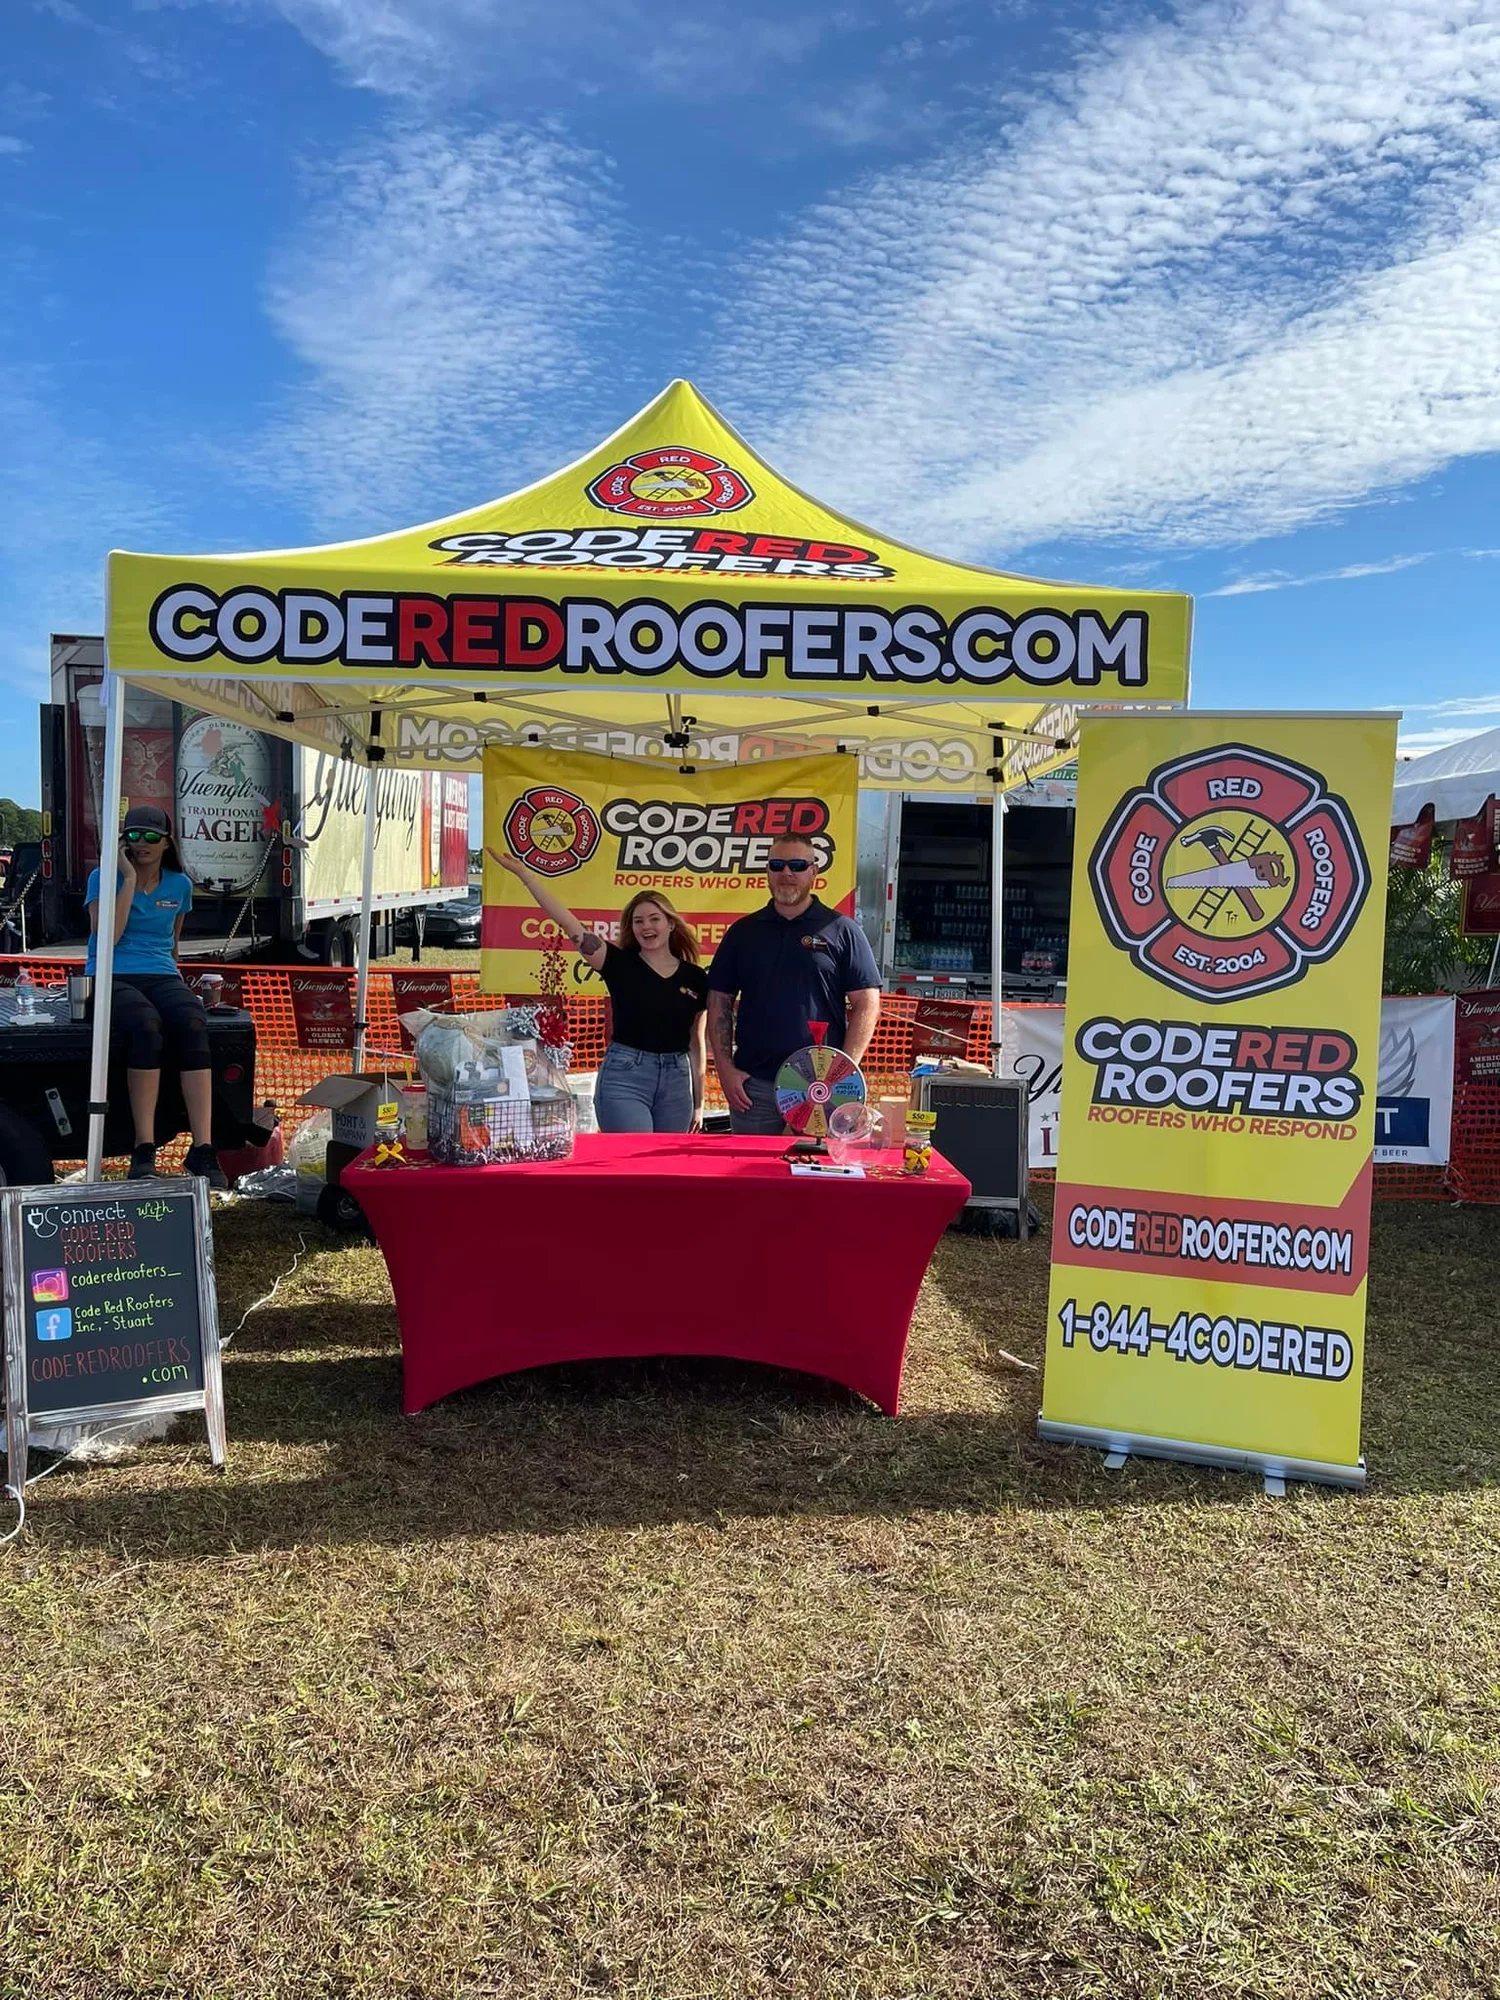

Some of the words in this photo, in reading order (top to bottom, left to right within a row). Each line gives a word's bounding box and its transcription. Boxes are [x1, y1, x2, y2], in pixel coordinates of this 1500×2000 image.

[659, 456, 691, 464] RED
[610, 475, 627, 497] CODE
[716, 474, 735, 504] ROOFERS
[662, 504, 695, 513] 2004
[438, 529, 871, 564] CODERED
[459, 550, 890, 578] ROOFERS
[153, 588, 1144, 683] CODEREDROOFERS.COM
[544, 796, 563, 804] RED
[1207, 777, 1262, 799] RED
[188, 806, 260, 818] TRADITIONAL
[605, 802, 826, 836] CODERED
[180, 817, 266, 843] LAGER
[518, 815, 528, 842] CODE
[578, 814, 590, 851] ROOFERS
[550, 857, 568, 867] 2004
[623, 834, 831, 869] ROOFES
[613, 873, 694, 889] ROOFERS
[699, 876, 741, 889] WHO
[1130, 833, 1158, 905] CODE
[1300, 827, 1333, 931] ROOFERS
[1173, 945, 1213, 973] EST.
[1214, 948, 1266, 975] 2004
[293, 978, 347, 993] Yuengling
[396, 979, 450, 994] Yuengling
[1080, 1021, 1351, 1074] CODERED
[1099, 1062, 1358, 1117] ROOFERS
[335, 1113, 357, 1129] PORT
[1087, 1105, 1186, 1129] ROOFERS
[1190, 1114, 1245, 1134] WHO
[1249, 1117, 1358, 1141] RESPOND
[1382, 1149, 1409, 1157] BEER
[59, 1225, 100, 1243] CODE
[106, 1221, 136, 1240] RED
[1069, 1206, 1352, 1273] CODEREDROOFERS.COM
[62, 1240, 138, 1265] ROOFERS
[74, 1304, 102, 1319] Code
[104, 1299, 124, 1314] Red
[126, 1293, 174, 1312] Roofers
[112, 1313, 155, 1331] Stuart
[1059, 1301, 1352, 1378] 1-844-4CODERED
